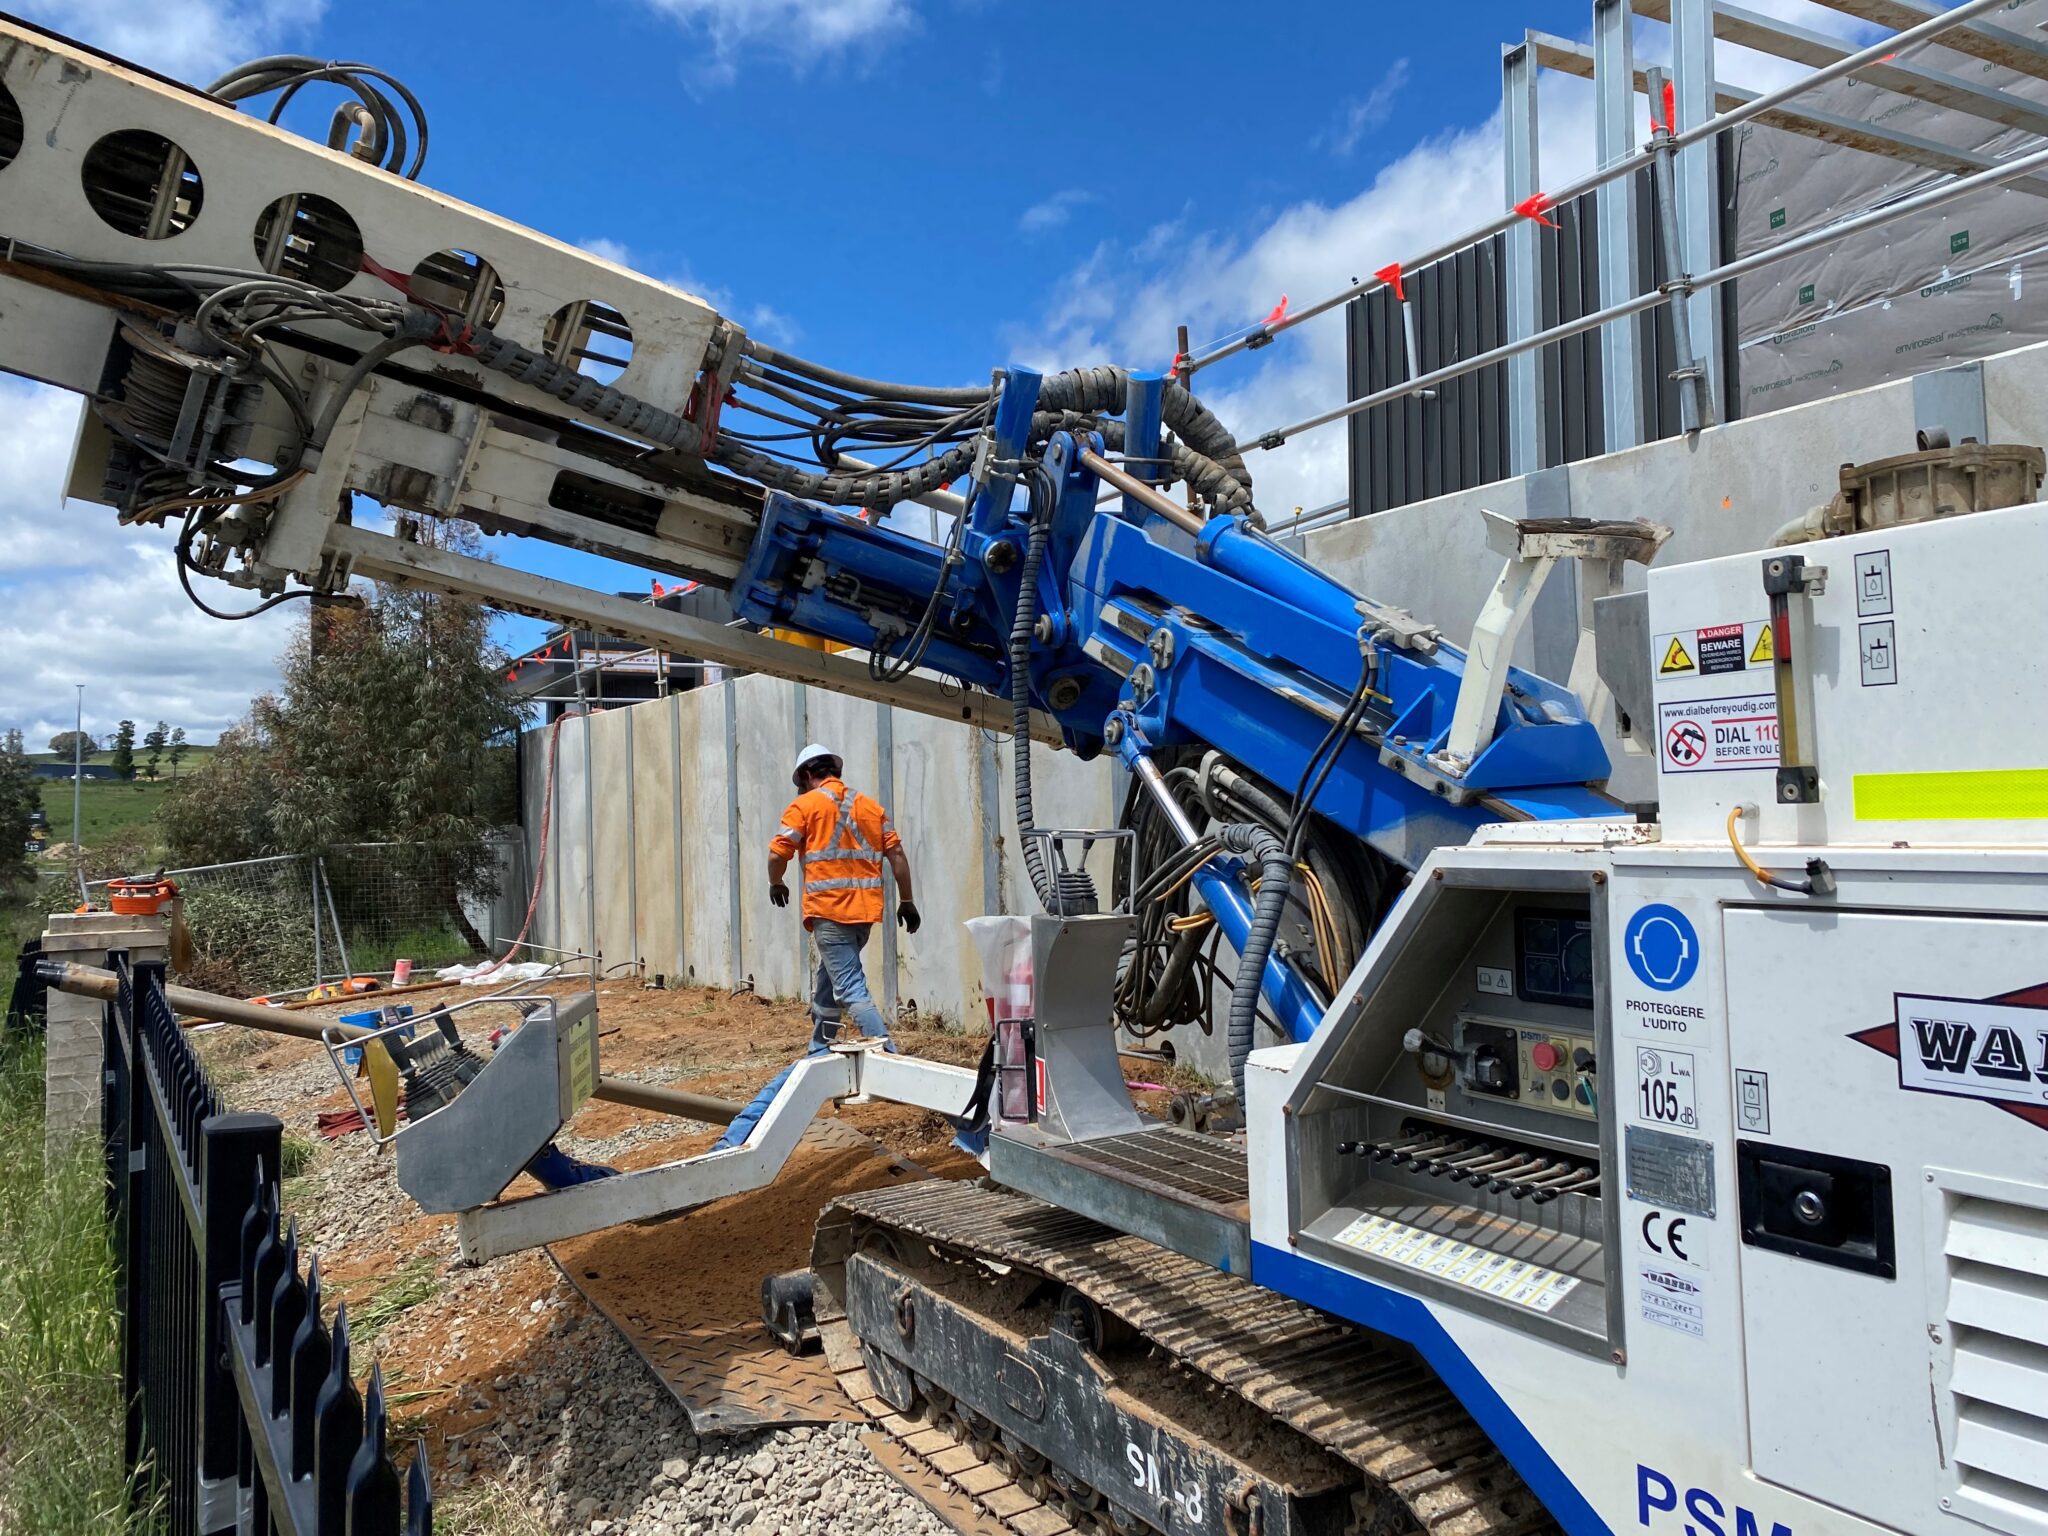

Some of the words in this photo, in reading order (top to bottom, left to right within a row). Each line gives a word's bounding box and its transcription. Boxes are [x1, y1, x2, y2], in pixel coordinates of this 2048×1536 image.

[1895, 332, 1945, 354] enviroseal
[1707, 625, 1742, 638] DANGER
[1700, 639, 1741, 652] BEWARE
[1715, 726, 1751, 744] DIAL
[1715, 746, 1751, 757] BEFORE
[1753, 744, 1772, 755] YOU
[1626, 1000, 1705, 1019] PROTEGGERE
[1642, 1017, 1687, 1033] L'UDITO
[1641, 1077, 1678, 1122] 105
[1680, 1106, 1695, 1125] dB
[1642, 1211, 1688, 1261] CE
[1649, 1273, 1692, 1293] WARNER
